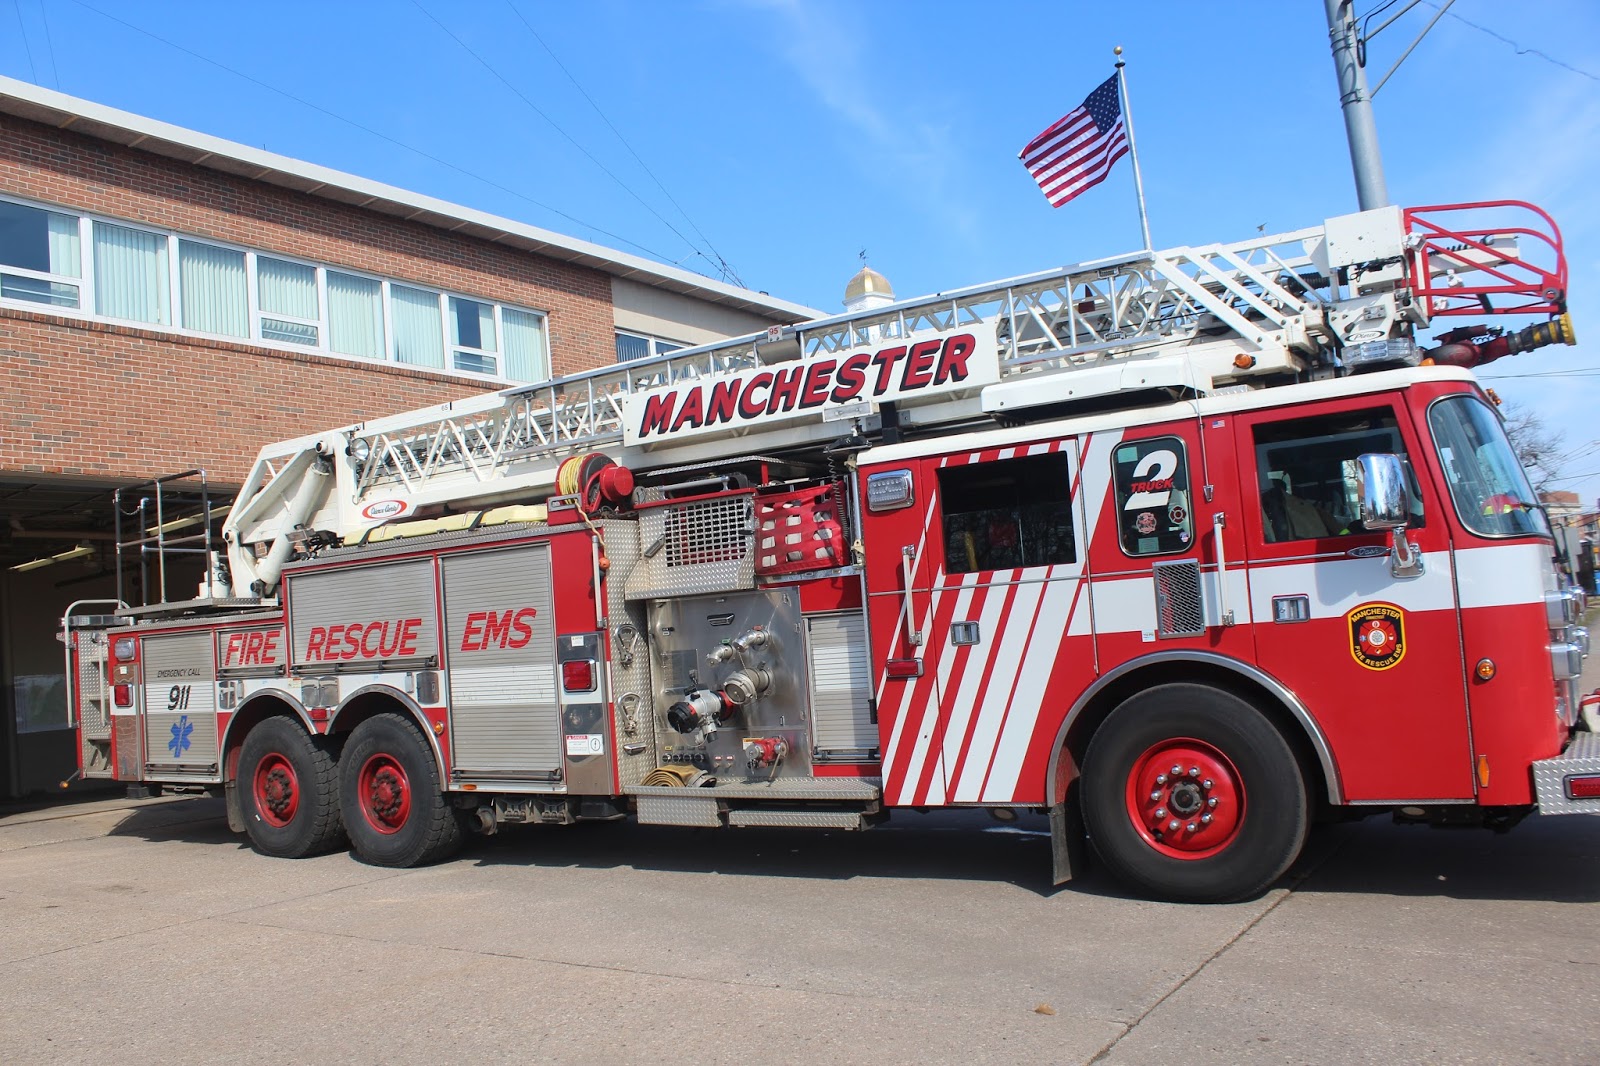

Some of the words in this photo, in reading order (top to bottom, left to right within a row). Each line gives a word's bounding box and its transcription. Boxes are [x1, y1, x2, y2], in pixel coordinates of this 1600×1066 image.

[768, 327, 779, 335] 95
[639, 334, 976, 438] MANCHESTER
[1124, 450, 1177, 510] 2
[1131, 478, 1174, 493] TRUCK
[1351, 608, 1400, 622] MANCHESTER
[224, 630, 280, 666] FIRE
[305, 618, 422, 662] RESCUE
[461, 608, 537, 652] EMS
[1354, 645, 1365, 660] FIRE
[1365, 656, 1395, 667] RESCUE
[1393, 643, 1402, 658] EMS
[157, 669, 187, 677] EMERGENCY
[188, 668, 201, 676] CALL
[167, 685, 191, 711] 911
